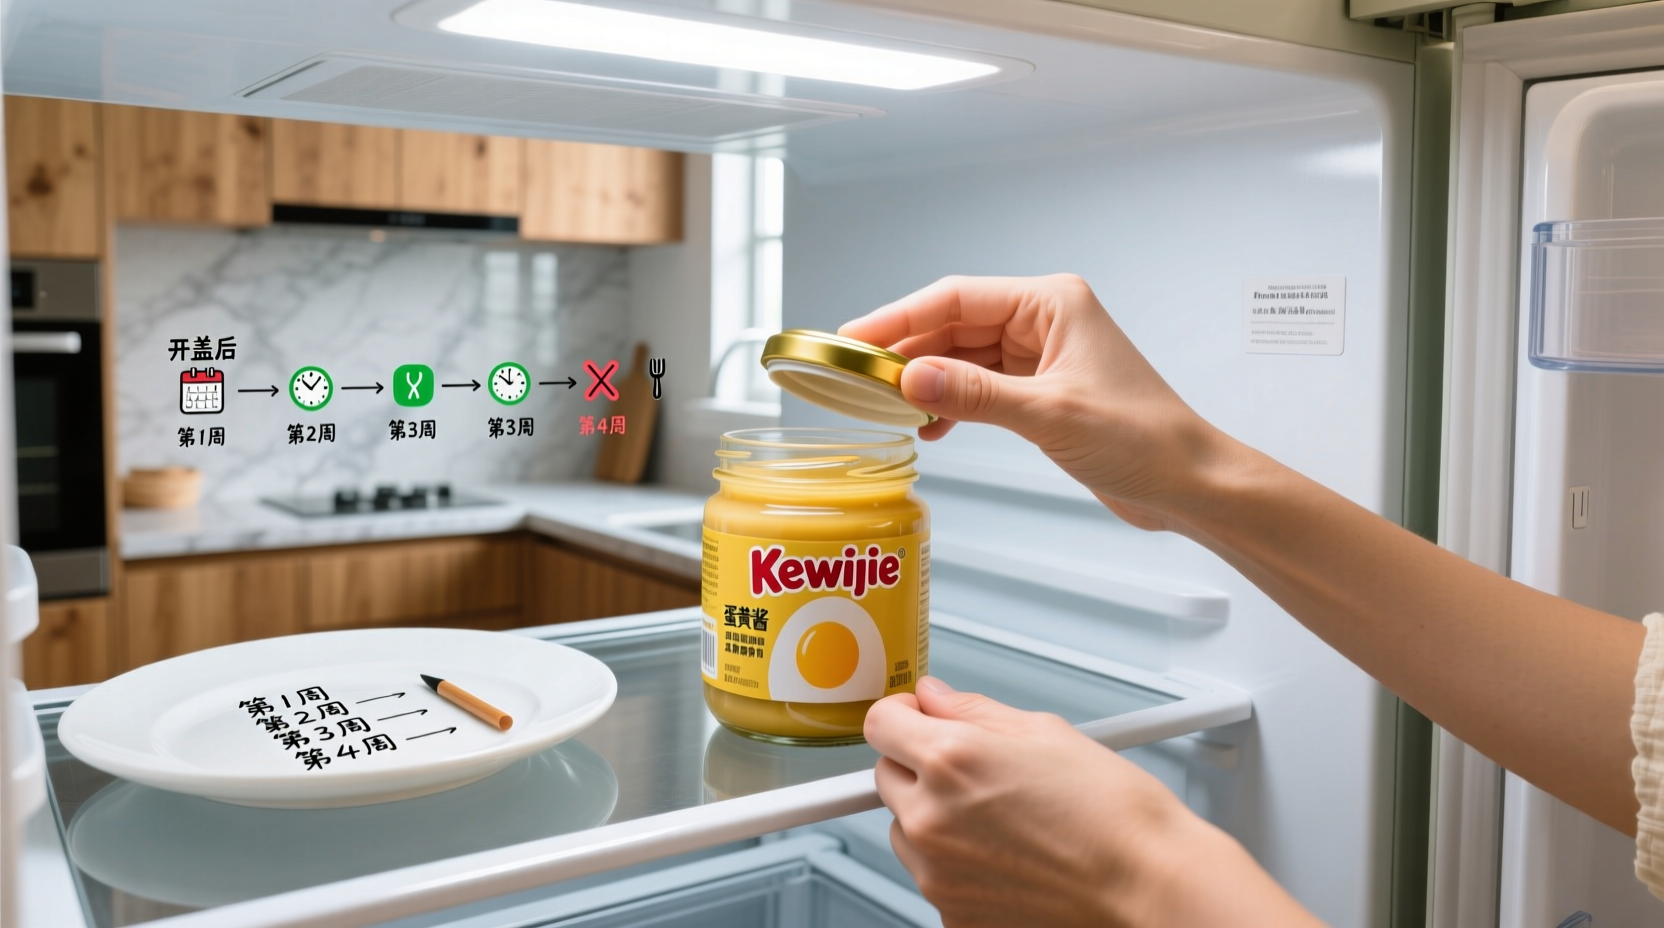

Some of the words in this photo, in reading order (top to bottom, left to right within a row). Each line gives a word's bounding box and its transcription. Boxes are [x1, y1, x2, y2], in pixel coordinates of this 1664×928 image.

[751, 546, 900, 597] Kewijie
[723, 604, 769, 632] 蛋黄酱
[238, 686, 330, 718] 第1周
[256, 701, 350, 733] 第2周
[273, 717, 371, 750] 第3周
[295, 734, 397, 770] 第4周
